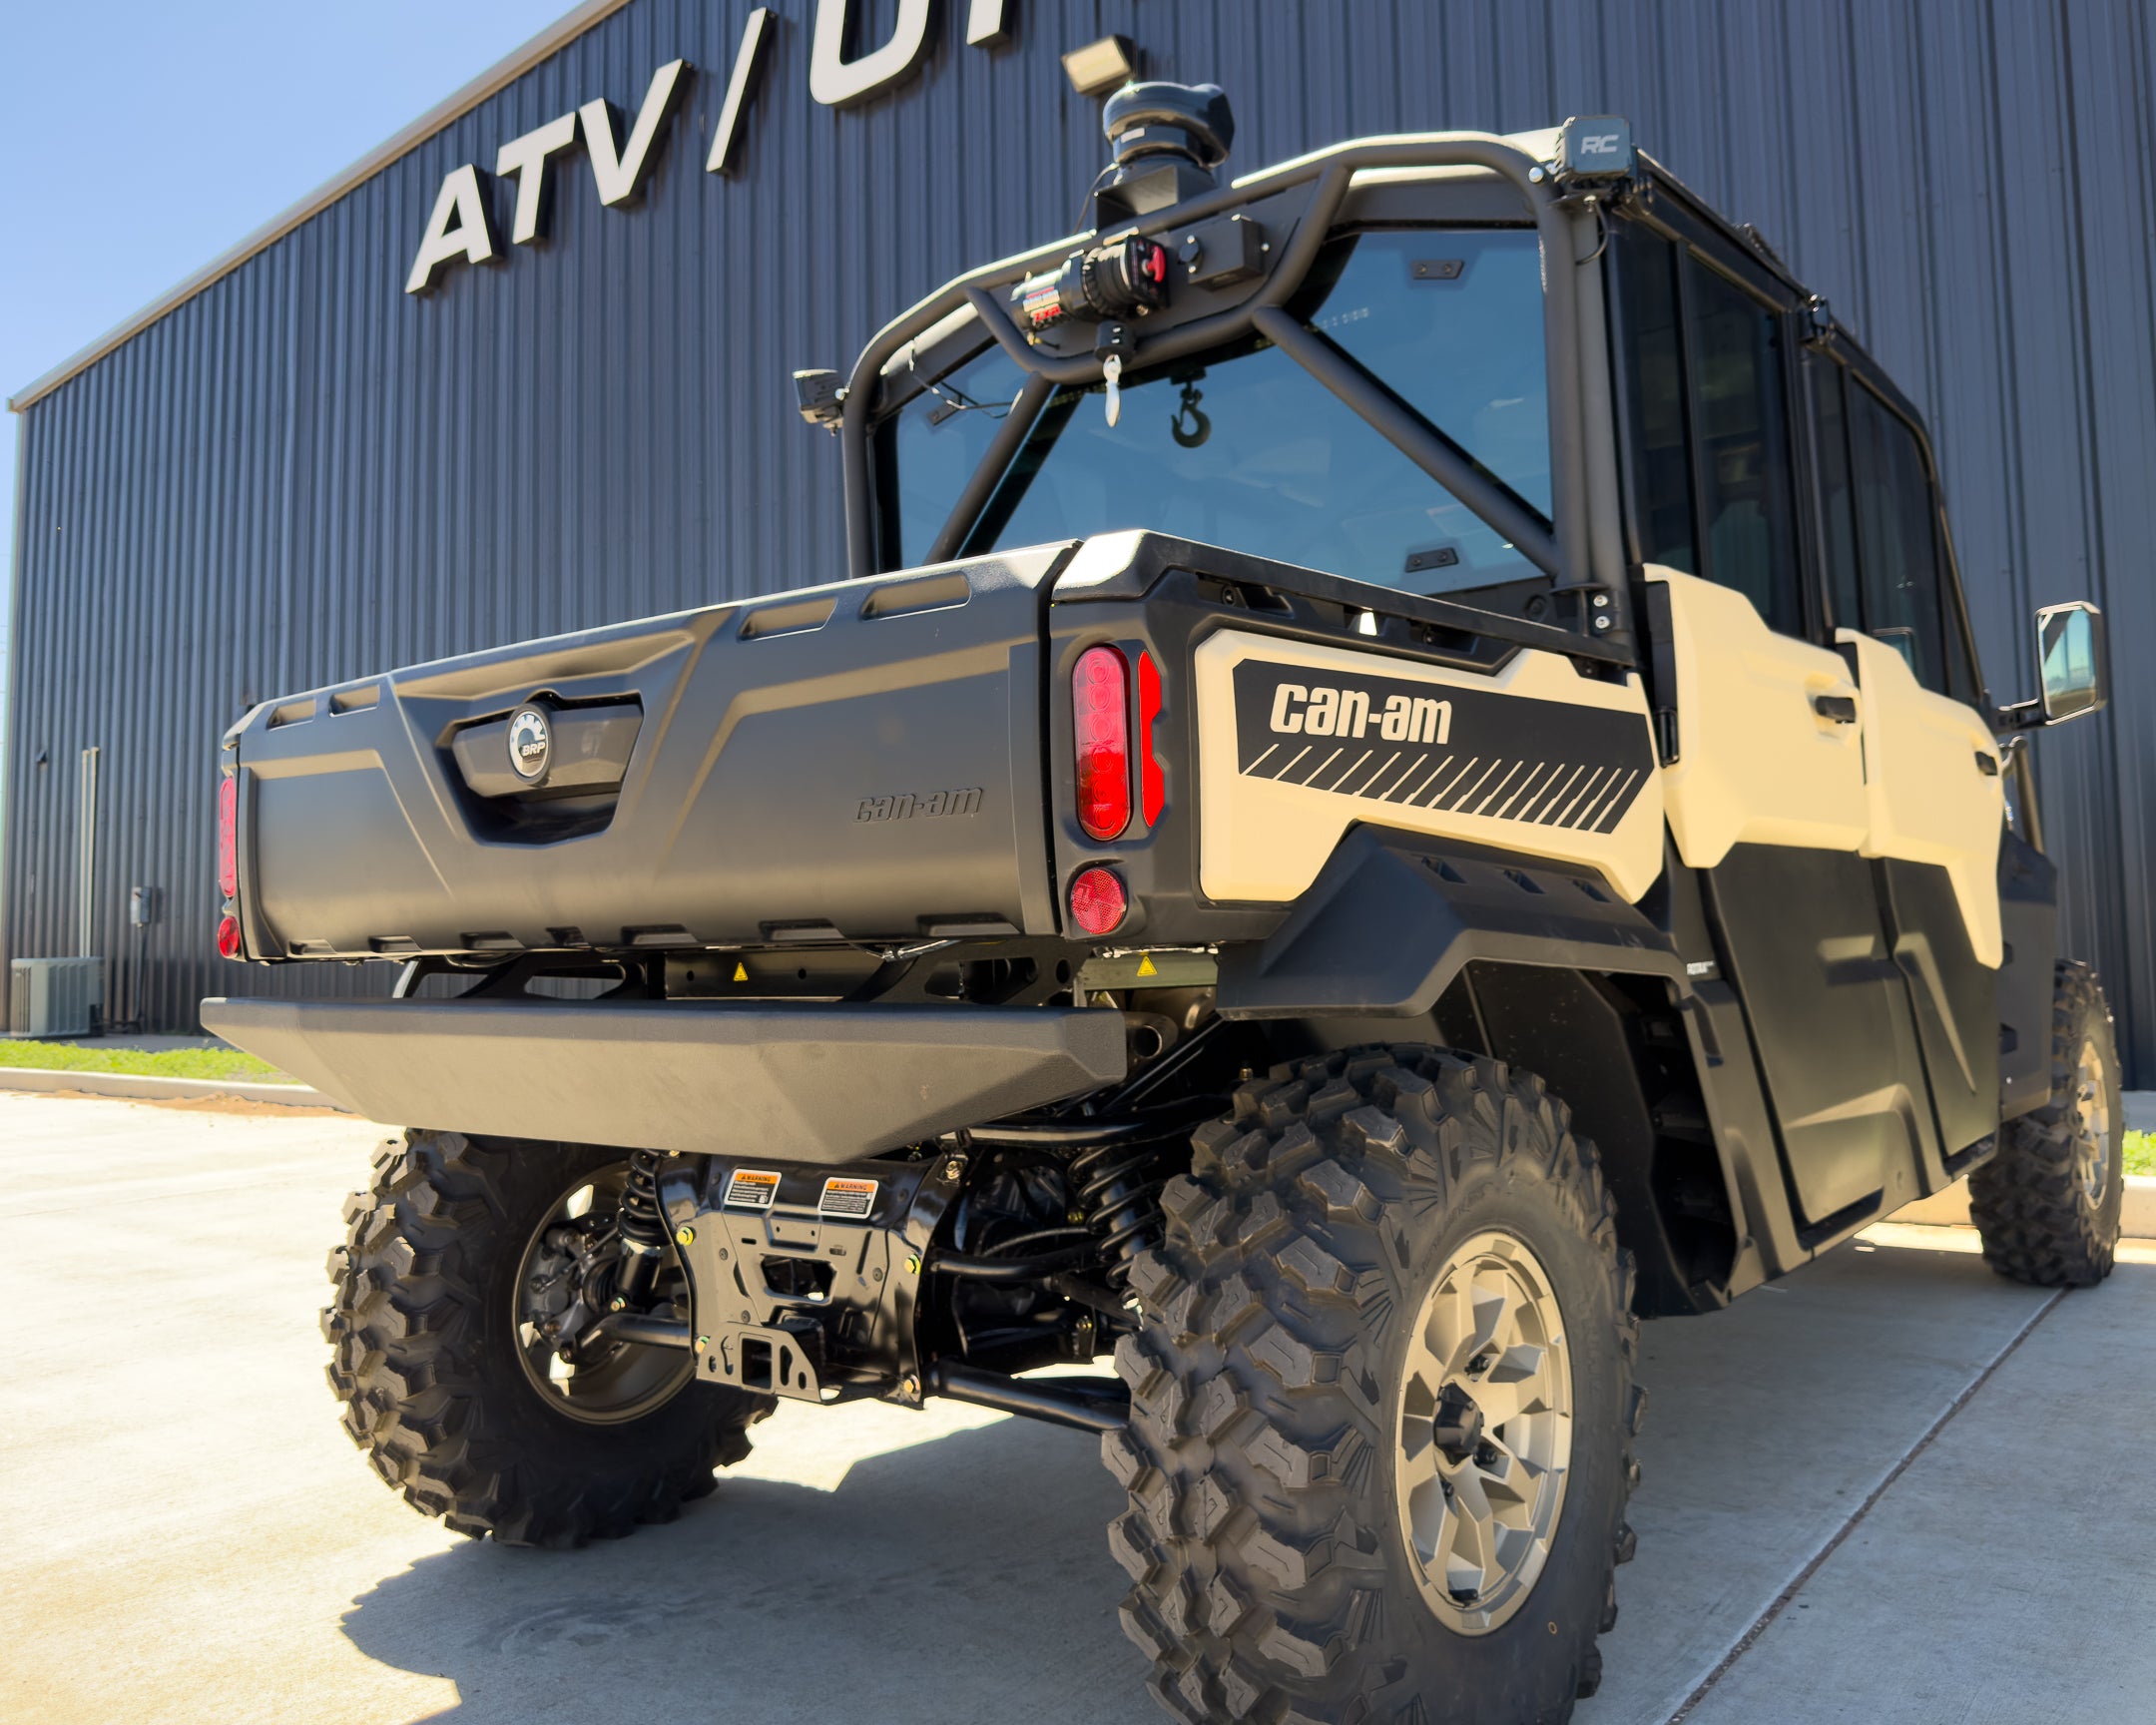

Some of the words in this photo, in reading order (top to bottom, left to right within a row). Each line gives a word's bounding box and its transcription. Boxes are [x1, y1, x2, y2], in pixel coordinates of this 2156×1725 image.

[1580, 134, 1620, 155] RC
[404, 58, 685, 294] ATV
[1269, 682, 1453, 746] can-am
[521, 741, 546, 757] BRP
[852, 787, 983, 823] can-am
